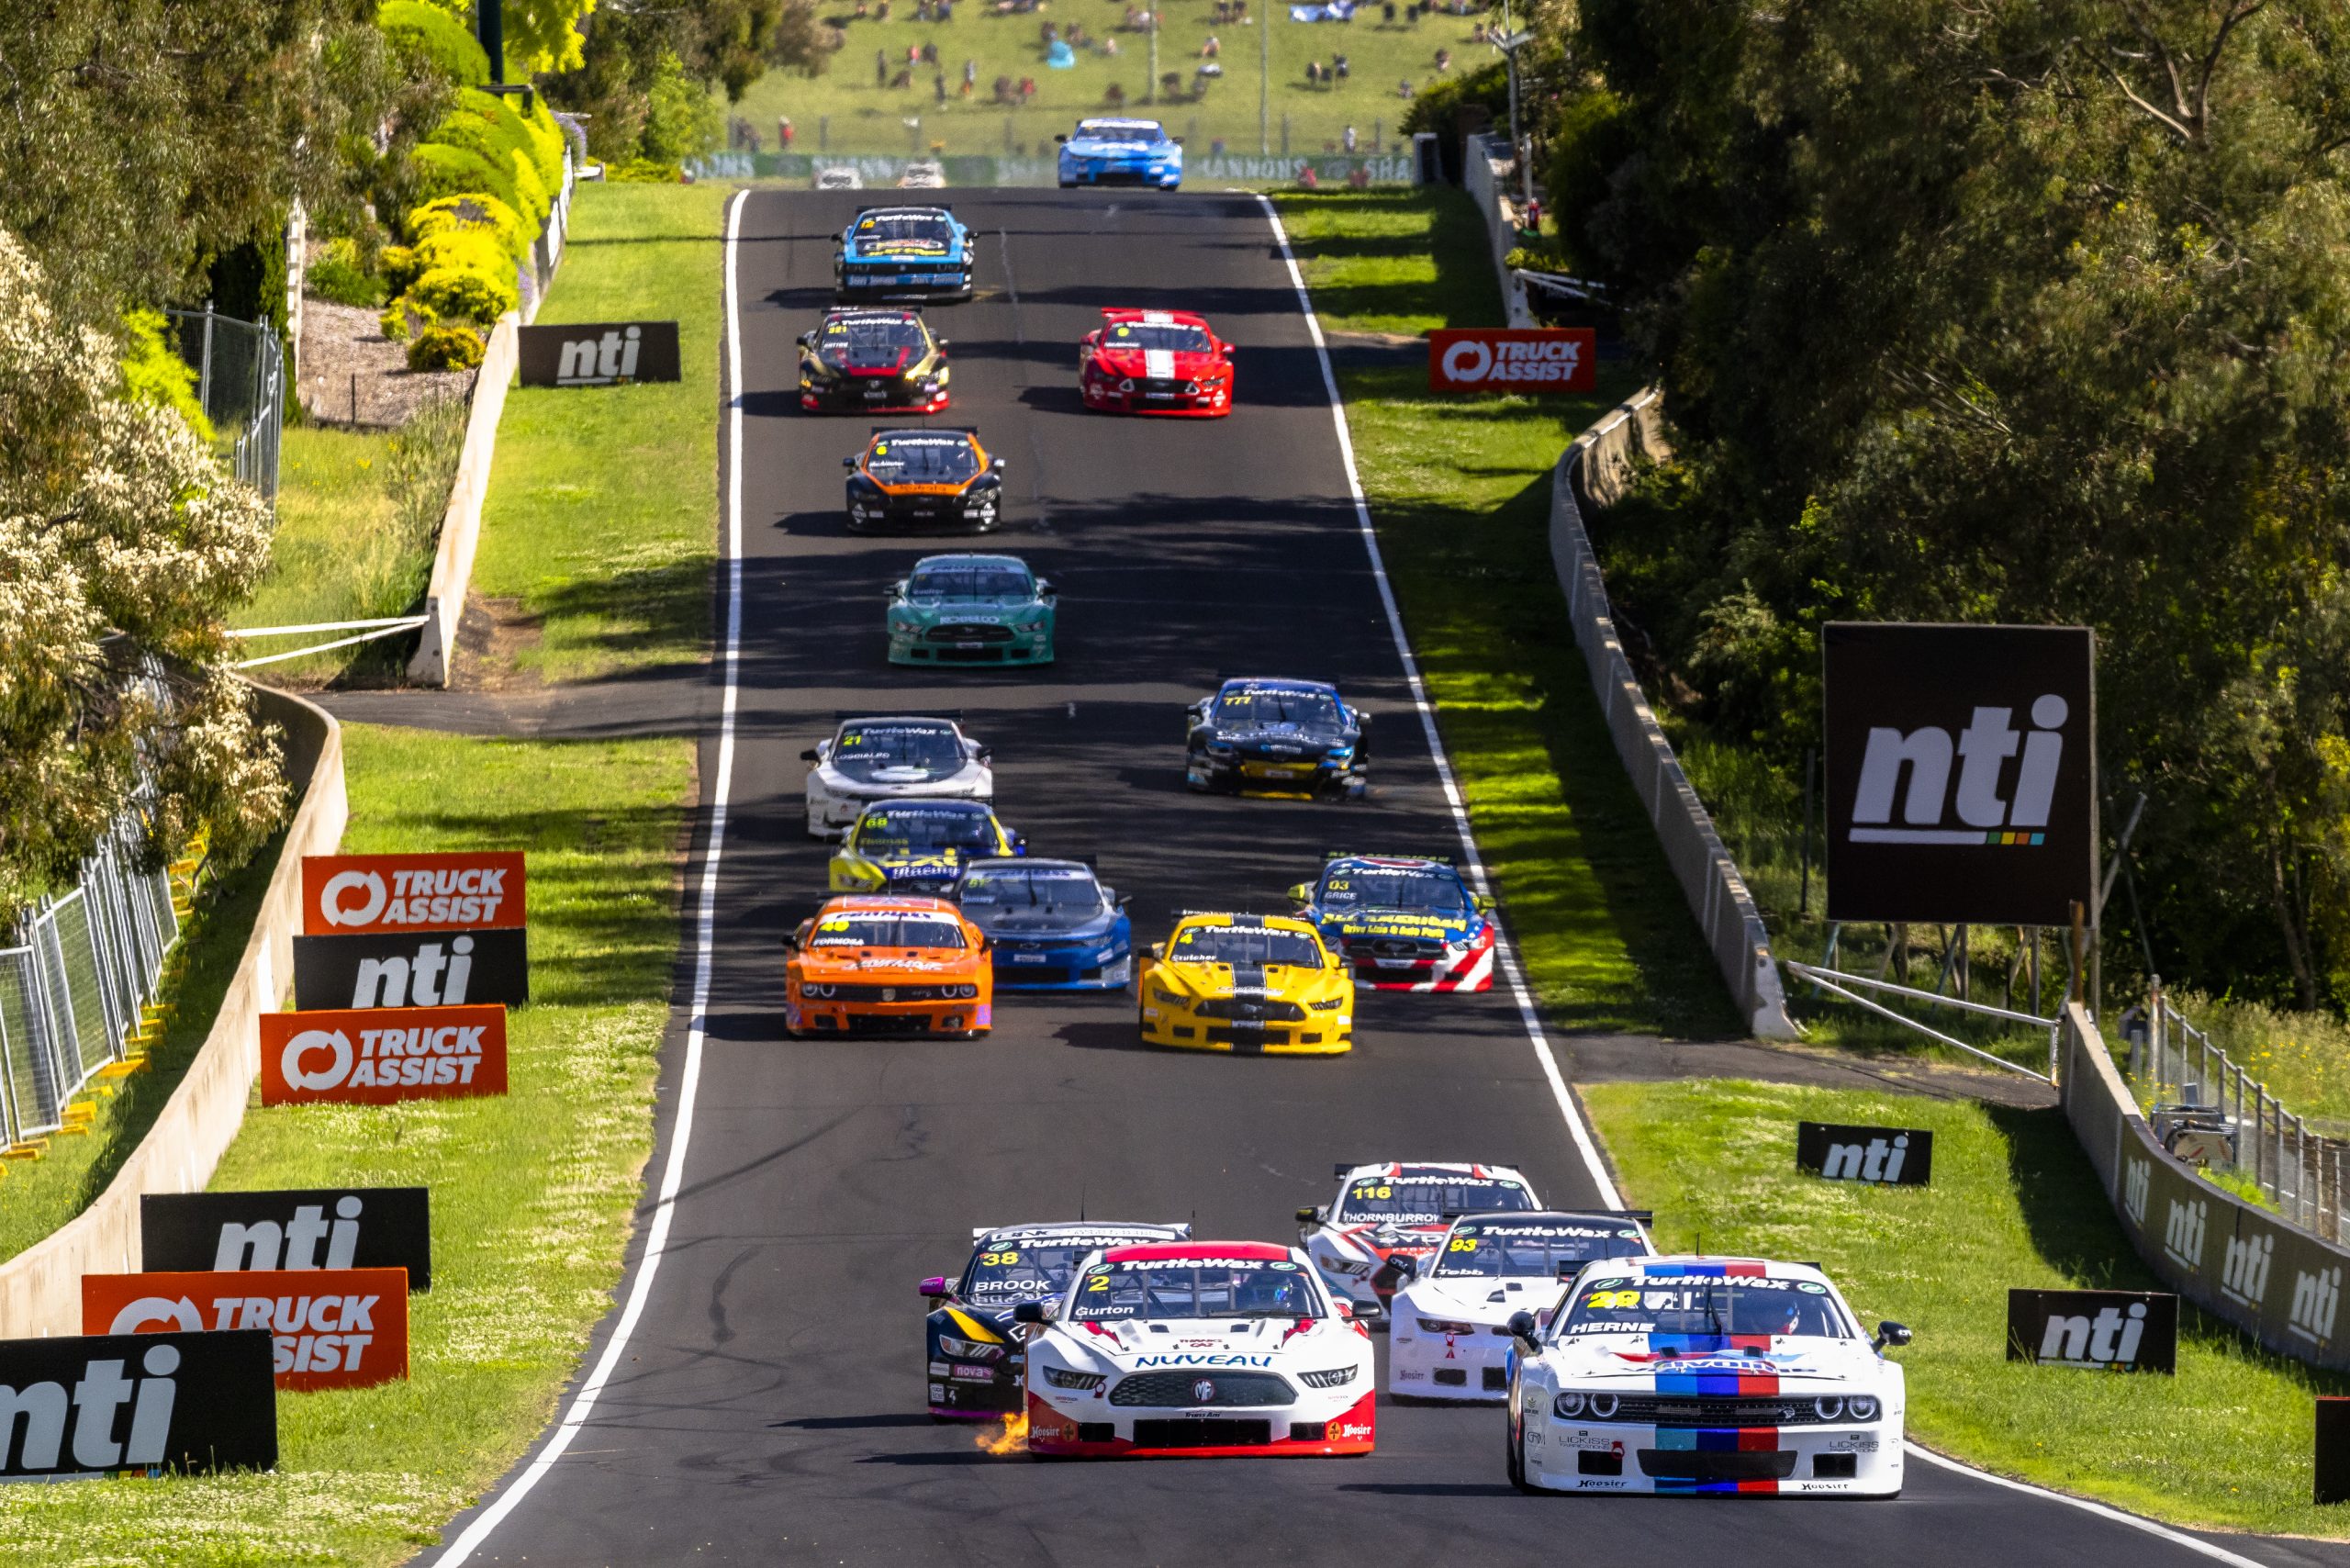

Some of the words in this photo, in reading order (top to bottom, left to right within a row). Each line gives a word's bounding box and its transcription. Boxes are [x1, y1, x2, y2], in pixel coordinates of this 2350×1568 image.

[556, 325, 641, 377] nti
[1495, 342, 1582, 361] TRUCK
[1487, 362, 1579, 381] ASSIST
[1242, 689, 1316, 699] TurtleWax
[861, 727, 937, 735] TurtleWax
[1852, 694, 2068, 827] nti
[1352, 868, 1436, 879] TurtleWax
[391, 868, 507, 897] TRUCK
[1328, 879, 1349, 890] 03
[1324, 891, 1358, 901] GRICE
[381, 896, 503, 925] ASSIST
[1204, 925, 1292, 936] TurtleWax
[812, 937, 865, 946] FORMOSA
[1179, 933, 1193, 944] 4
[352, 935, 475, 1009] nti
[359, 1026, 487, 1058] TRUCK
[348, 1055, 482, 1088] ASSIST
[1822, 1135, 1908, 1182] nti
[1383, 1176, 1494, 1187] TurtleWax
[1352, 1186, 1392, 1200] 116
[213, 1195, 363, 1272] nti
[1483, 1226, 1611, 1238] TurtleWax
[2165, 1198, 2207, 1268] nti
[1449, 1238, 1478, 1251] 93
[982, 1251, 1019, 1266] 38
[1120, 1258, 1264, 1271] TurtleWax
[2221, 1234, 2274, 1304] nti
[974, 1280, 1052, 1292] BROOK
[1088, 1275, 1110, 1292] 2
[1630, 1275, 1791, 1291] TurtleWax
[2289, 1267, 2342, 1339] nti
[212, 1295, 380, 1333] TRUCK
[1075, 1305, 1135, 1316] Gurton
[1570, 1322, 1657, 1334] HERNE
[2039, 1303, 2147, 1362] nti
[274, 1335, 373, 1373] SIST
[1136, 1354, 1272, 1369] NUVEAU
[957, 1366, 984, 1377] nova
[0, 1344, 181, 1469] nti
[1031, 1426, 1060, 1439] Hoosier
[1343, 1424, 1372, 1438] Hoosier
[1559, 1436, 1610, 1446] LICKISS
[1830, 1440, 1880, 1449] LICKISS
[1576, 1480, 1628, 1488] Hoosier
